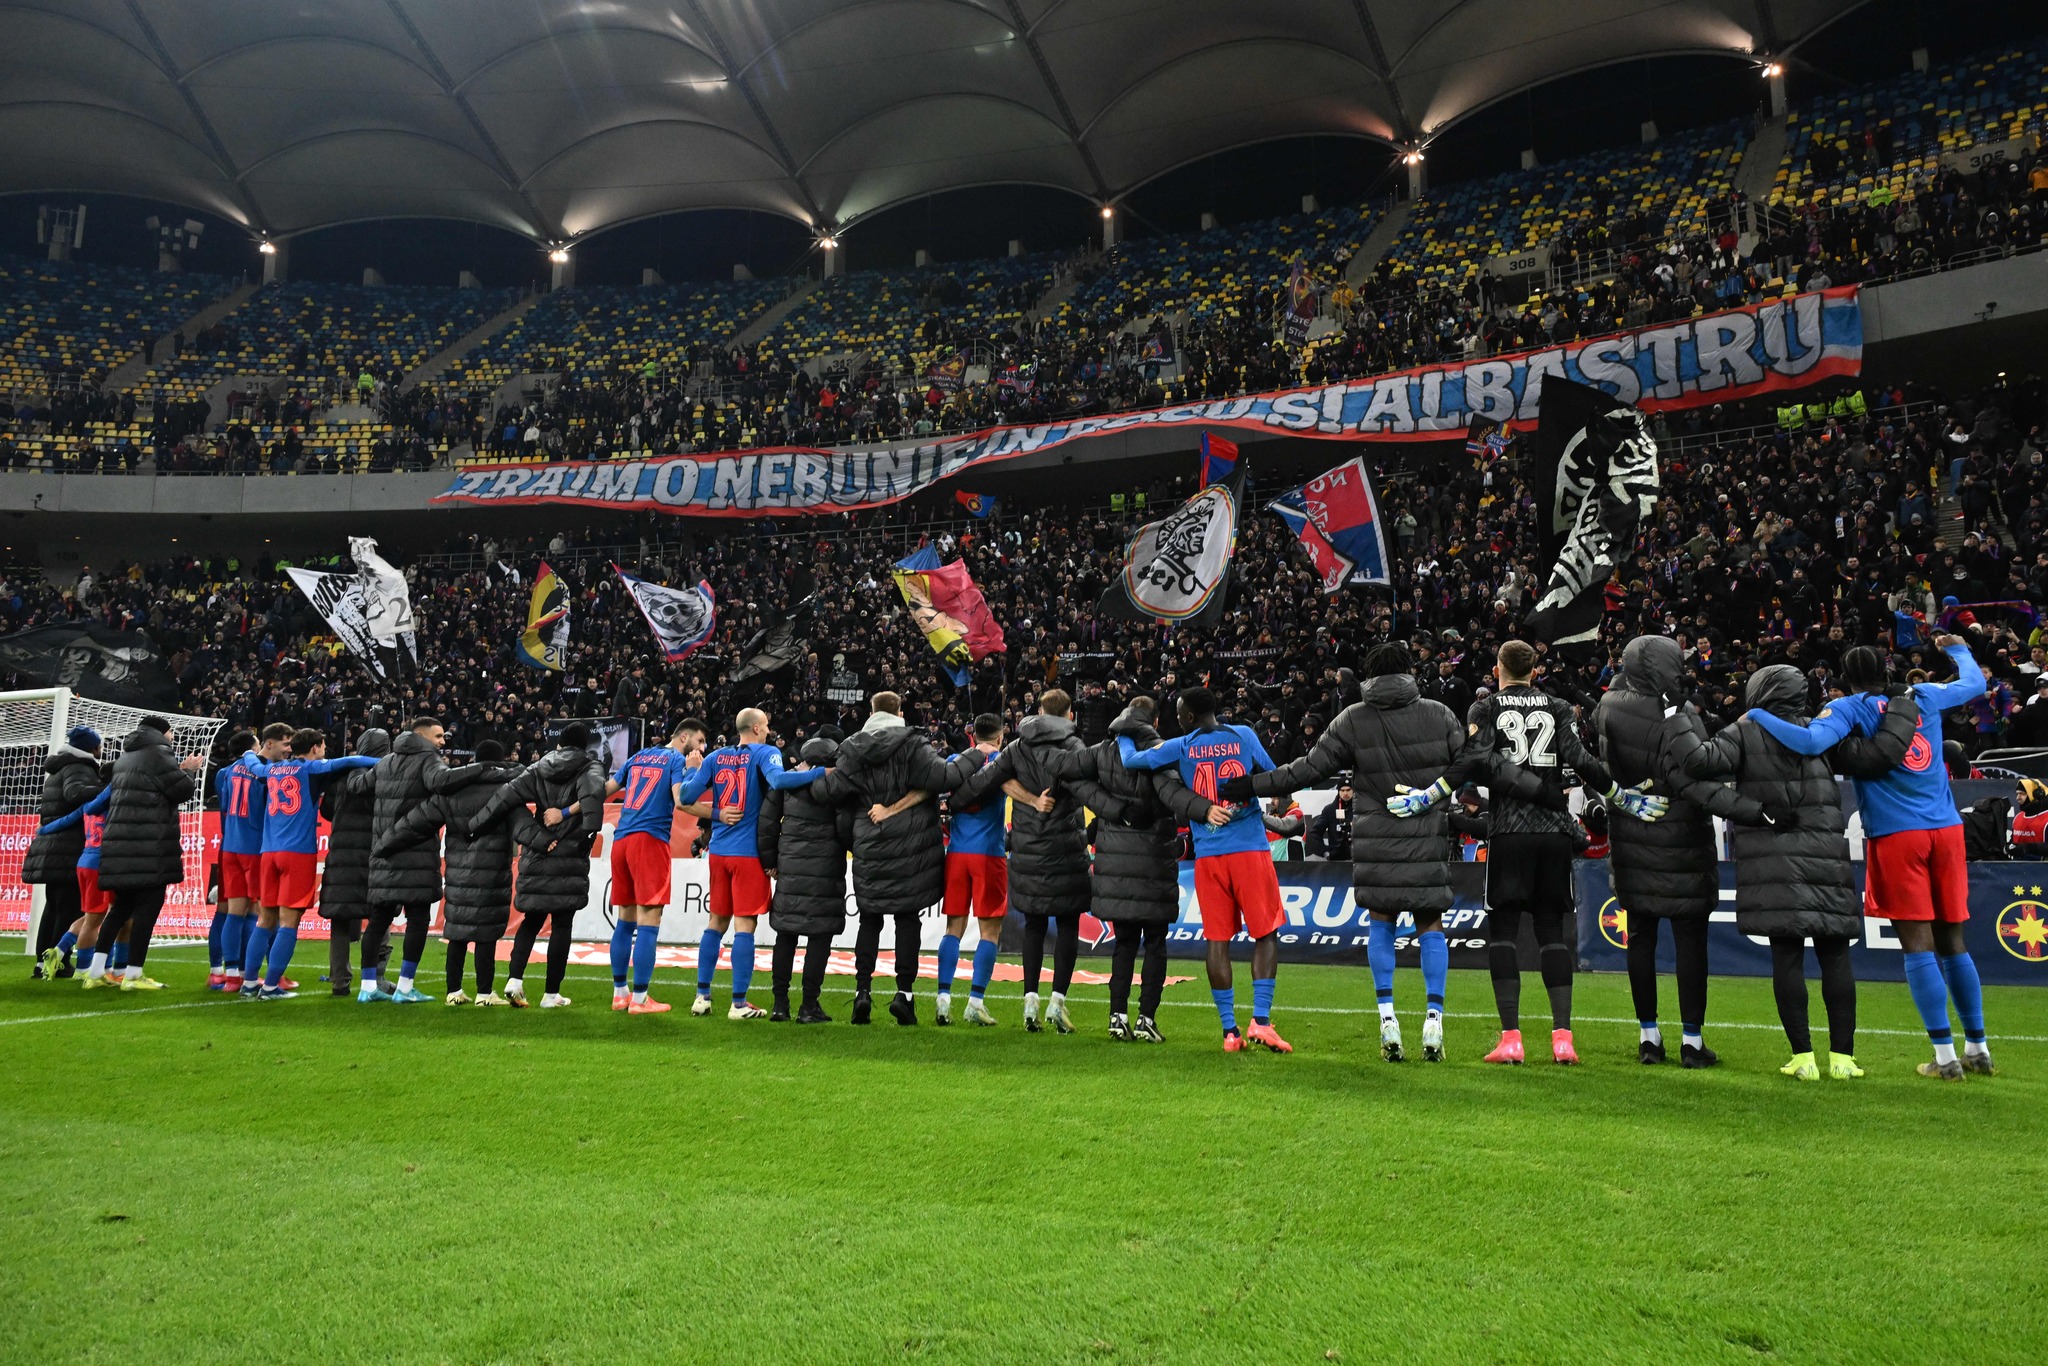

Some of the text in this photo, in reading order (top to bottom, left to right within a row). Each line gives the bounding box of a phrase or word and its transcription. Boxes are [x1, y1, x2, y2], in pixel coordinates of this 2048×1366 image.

[1509, 257, 1536, 271] 308
[452, 461, 647, 503] TRAIM
[651, 458, 699, 506] O
[1264, 384, 1349, 434] SI
[1356, 292, 1825, 434] ALBASTRU
[826, 688, 864, 702] SINCE
[1496, 695, 1549, 707] TARNOVANU
[1188, 742, 1241, 759] ALHASSAN
[1496, 710, 1557, 767] 32
[229, 775, 252, 819] 11
[267, 775, 303, 817] 33
[623, 765, 664, 811] 17
[714, 767, 747, 812] 21
[1309, 931, 1341, 946] în
